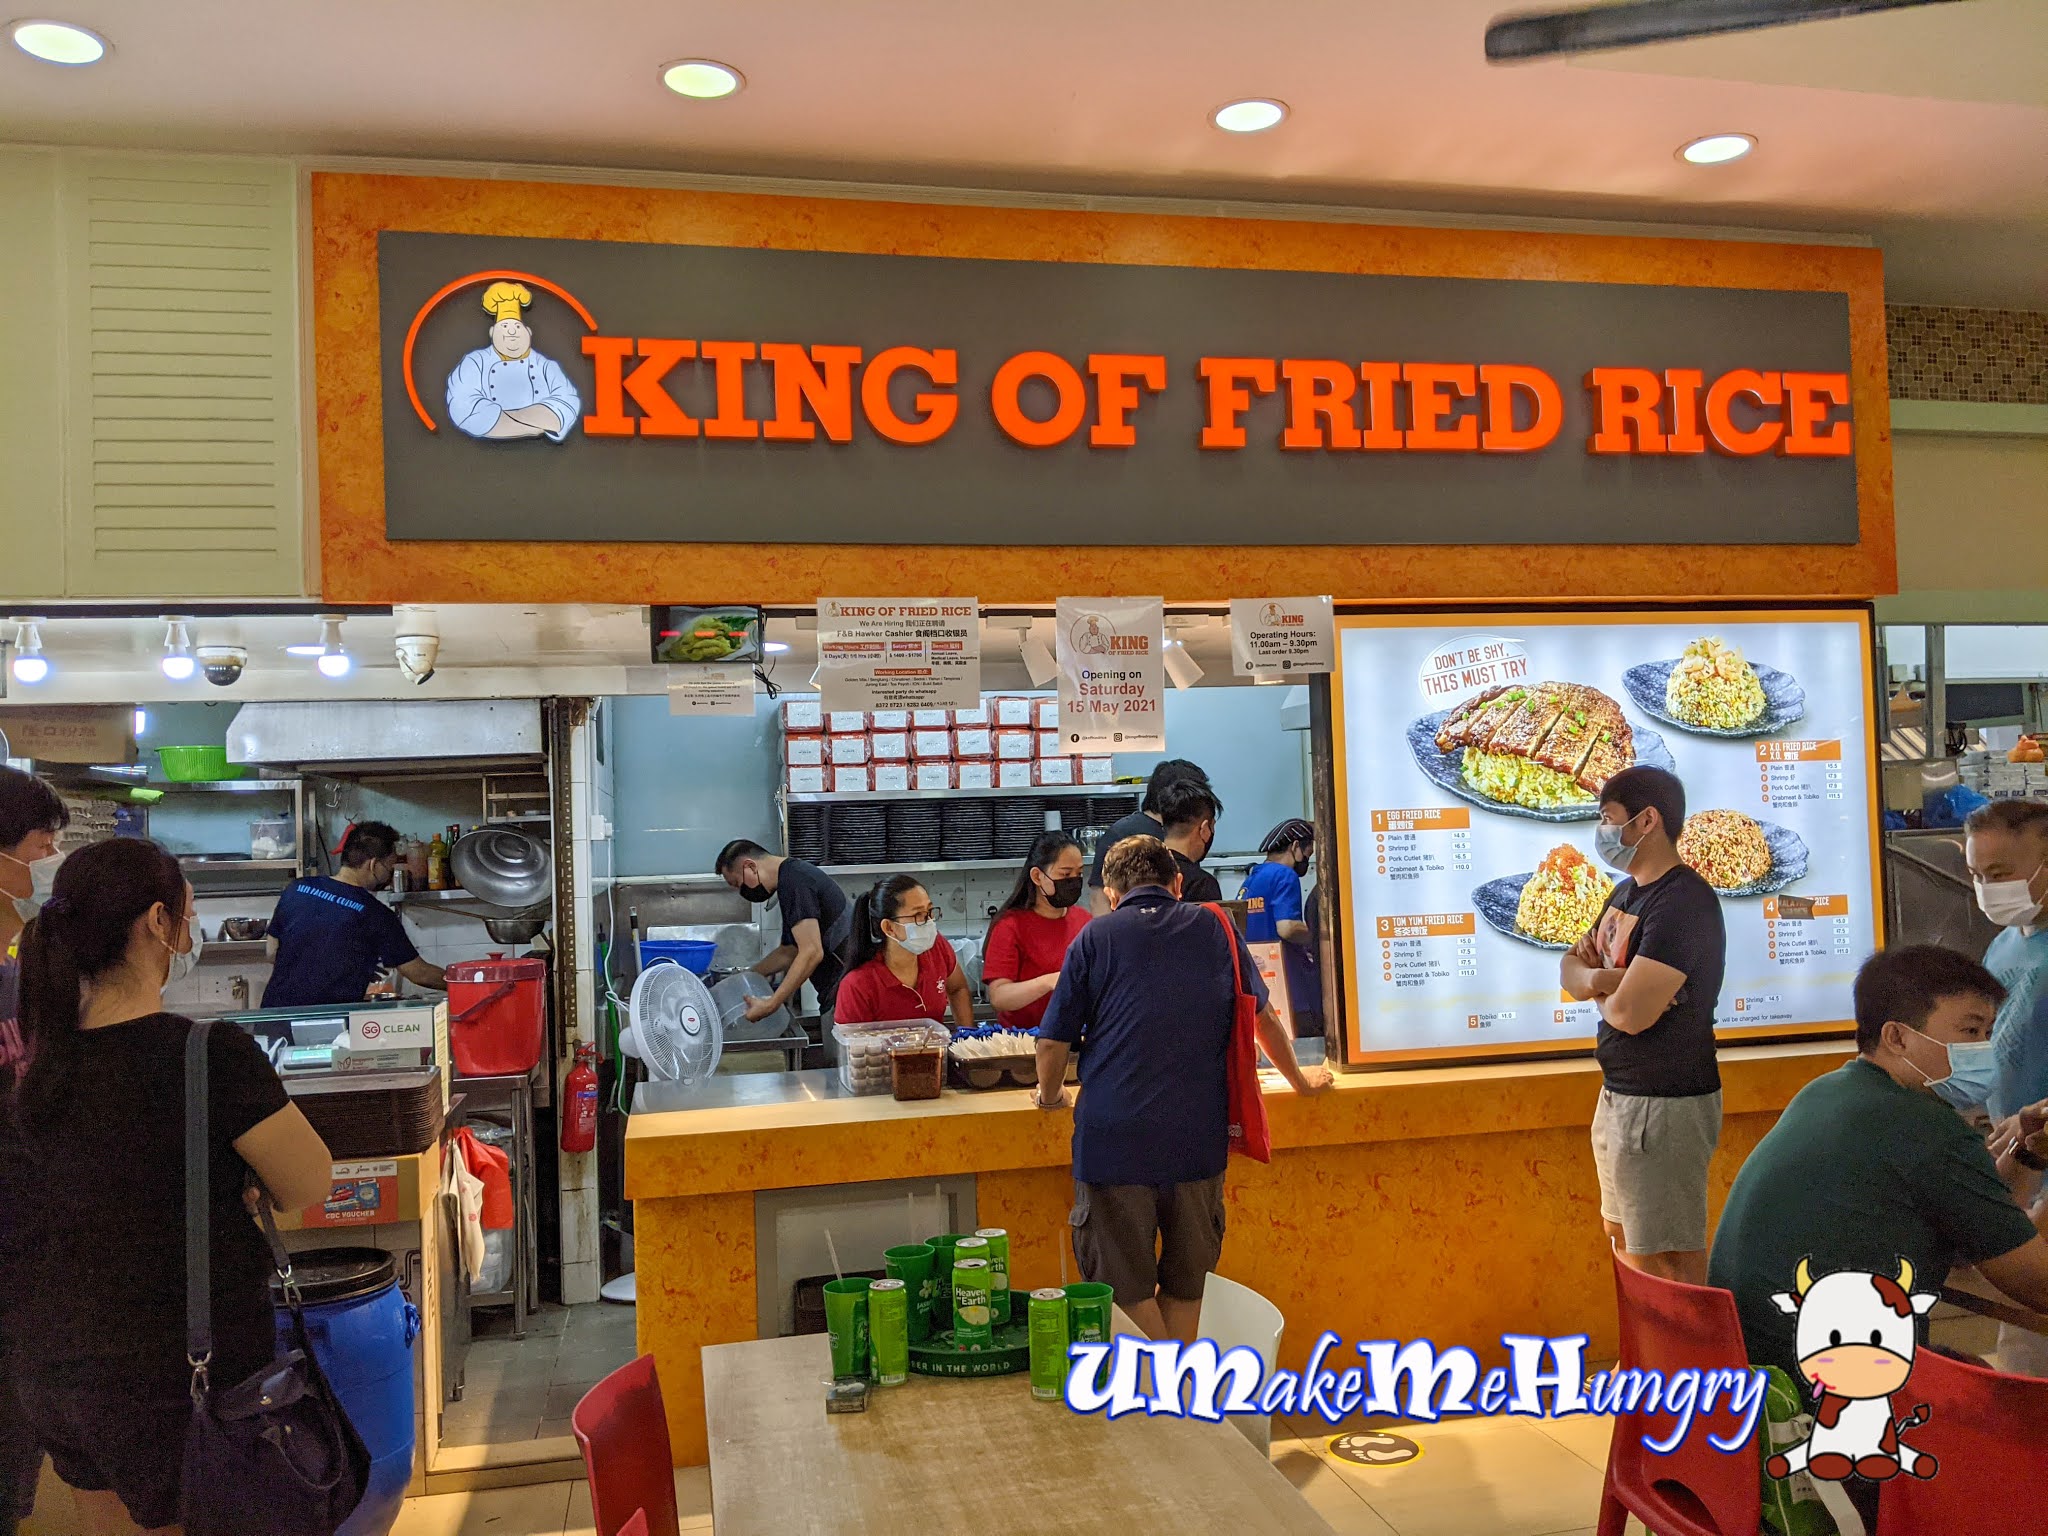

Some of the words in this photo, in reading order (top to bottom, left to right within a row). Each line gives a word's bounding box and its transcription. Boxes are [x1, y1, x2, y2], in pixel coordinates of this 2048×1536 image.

[581, 335, 960, 446] KING
[991, 350, 1166, 447] OF
[1199, 357, 1563, 453] FRIED
[1591, 367, 1852, 457] RICE
[840, 606, 875, 617] KING
[878, 606, 896, 617] OF
[899, 606, 938, 616] FRIED
[941, 606, 972, 616] RICE
[1282, 615, 1304, 624] KING
[1250, 631, 1288, 640] Operating
[1290, 630, 1316, 638] Hours:
[1110, 636, 1149, 650] KING
[1290, 640, 1317, 648] 9.30pm
[1434, 650, 1465, 670] DON'T
[1468, 648, 1482, 664] BE
[1082, 670, 1126, 681] Opening
[1424, 672, 1459, 696] THIS
[1462, 665, 1497, 687] MUST
[1501, 658, 1528, 680] TRY
[1080, 682, 1145, 698] Saturday
[1068, 700, 1084, 713] 15
[1090, 700, 1119, 715] May
[1124, 699, 1156, 712] 2021
[1760, 745, 1767, 756] 2
[1782, 742, 1801, 751] FRIED
[1802, 742, 1817, 751] RICE
[1376, 813, 1382, 825] 1
[1386, 811, 1400, 820] EGG
[1402, 810, 1423, 820] FRIED
[1424, 810, 1441, 819] RICE
[310, 888, 337, 902] PACIFIC
[336, 896, 365, 912] CUISINE
[1248, 896, 1265, 909] ING
[1766, 902, 1774, 912] 4
[1380, 920, 1389, 931] 3
[1392, 918, 1406, 927] TOM
[1408, 916, 1423, 926] YUM
[1424, 916, 1446, 925] FRIED
[1447, 914, 1464, 924] RICE
[1736, 1001, 1743, 1009] 8
[1470, 1018, 1477, 1026] 5
[1556, 1012, 1562, 1021] 6
[364, 1026, 378, 1034] SG
[384, 1024, 420, 1034] CLEAN
[342, 1210, 375, 1219] VOUCHER
[956, 1287, 986, 1297] Heaven
[962, 1296, 986, 1306] Earth
[932, 1364, 943, 1372] IN
[946, 1364, 967, 1373] THE
[972, 1362, 1010, 1372] WORLD
